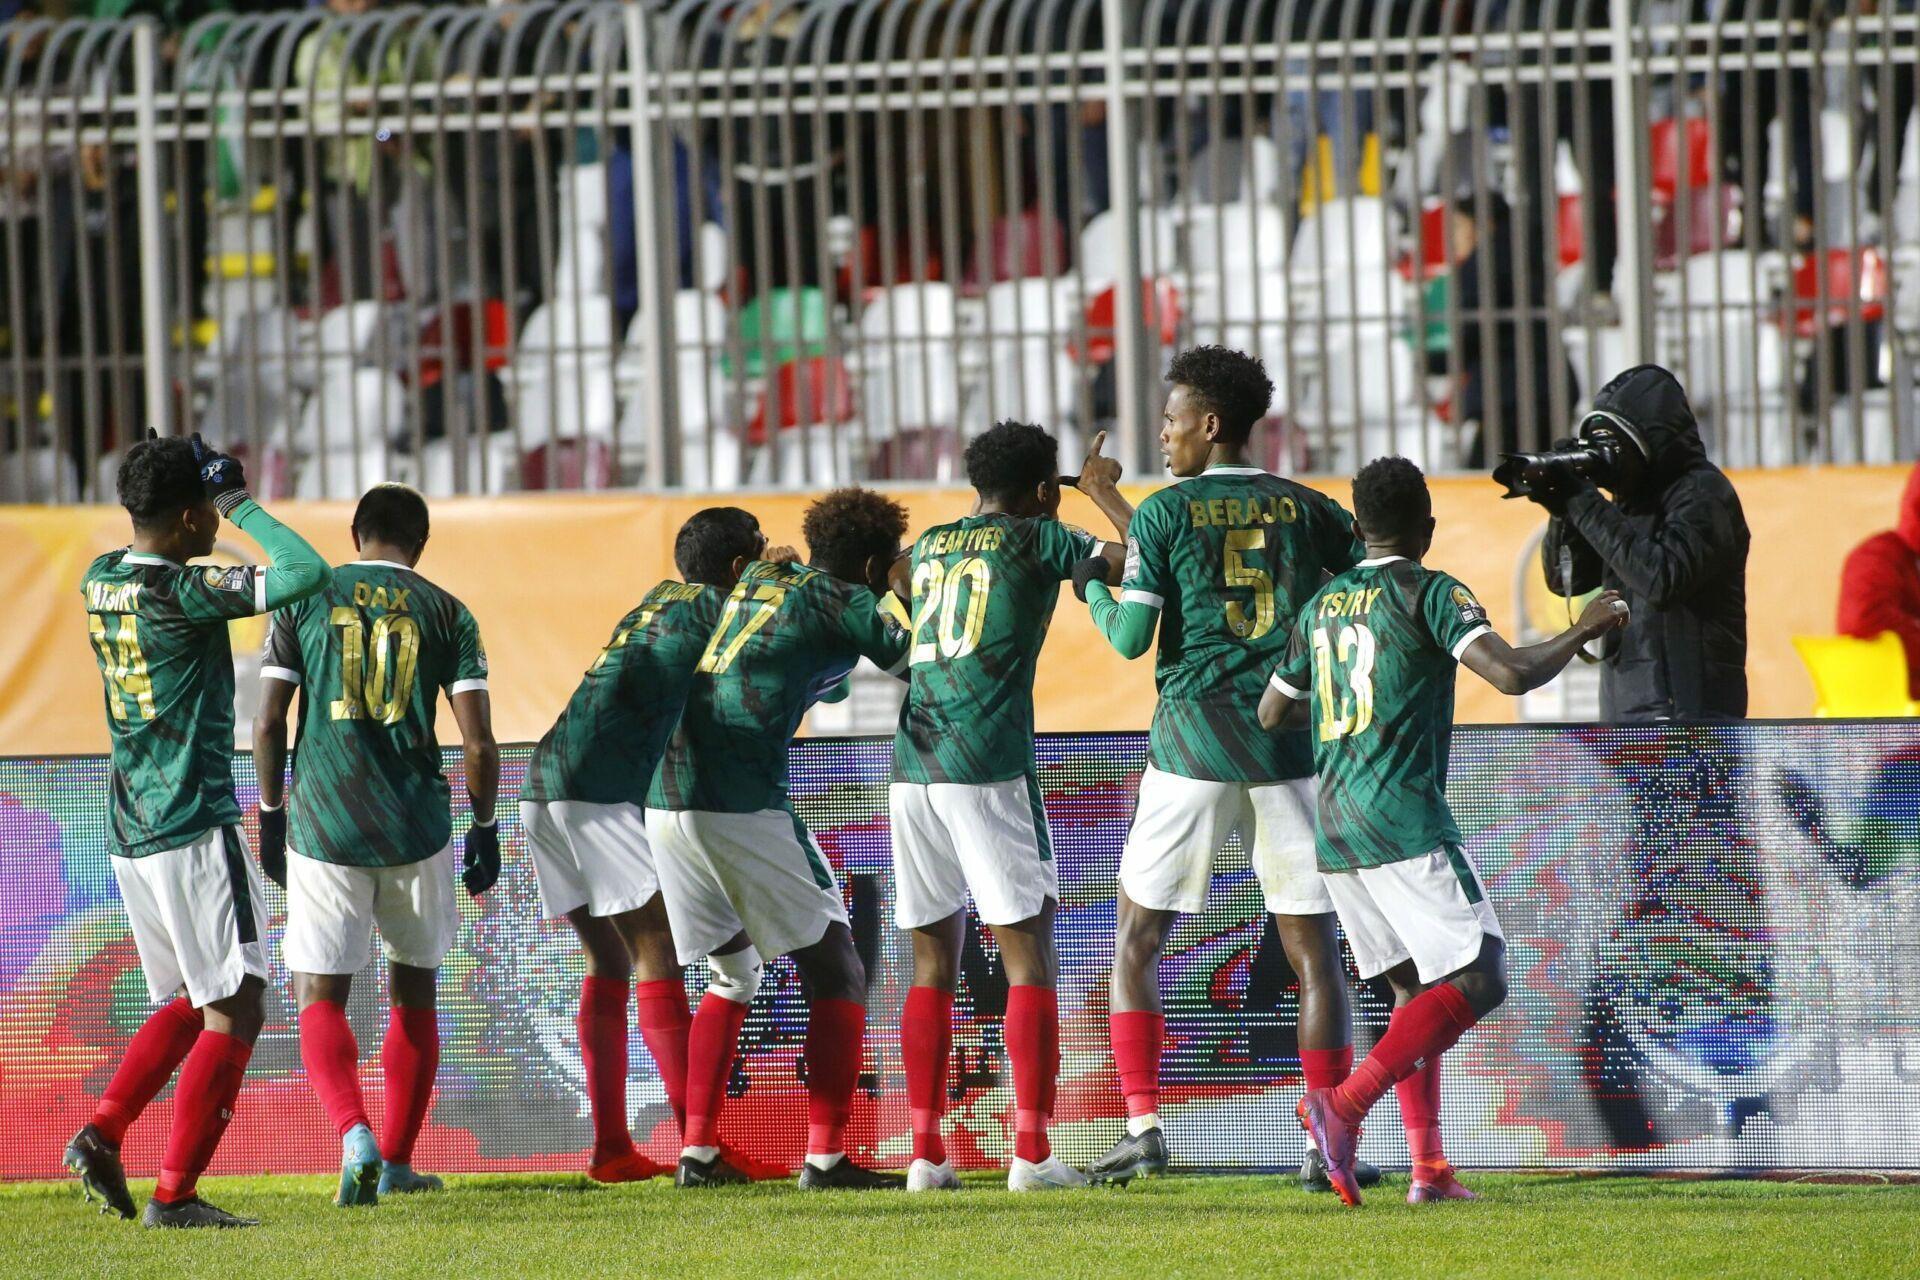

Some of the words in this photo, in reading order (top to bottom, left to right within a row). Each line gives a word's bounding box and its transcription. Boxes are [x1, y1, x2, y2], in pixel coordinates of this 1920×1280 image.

[1190, 496, 1297, 528] BERAJO
[354, 581, 411, 612] DAX
[693, 582, 787, 675] 17
[909, 557, 990, 667] 20
[1223, 528, 1275, 641] 5
[1318, 587, 1382, 620] TSIRY
[89, 613, 156, 720] 14
[329, 606, 420, 727] 10
[1312, 623, 1375, 742] 13
